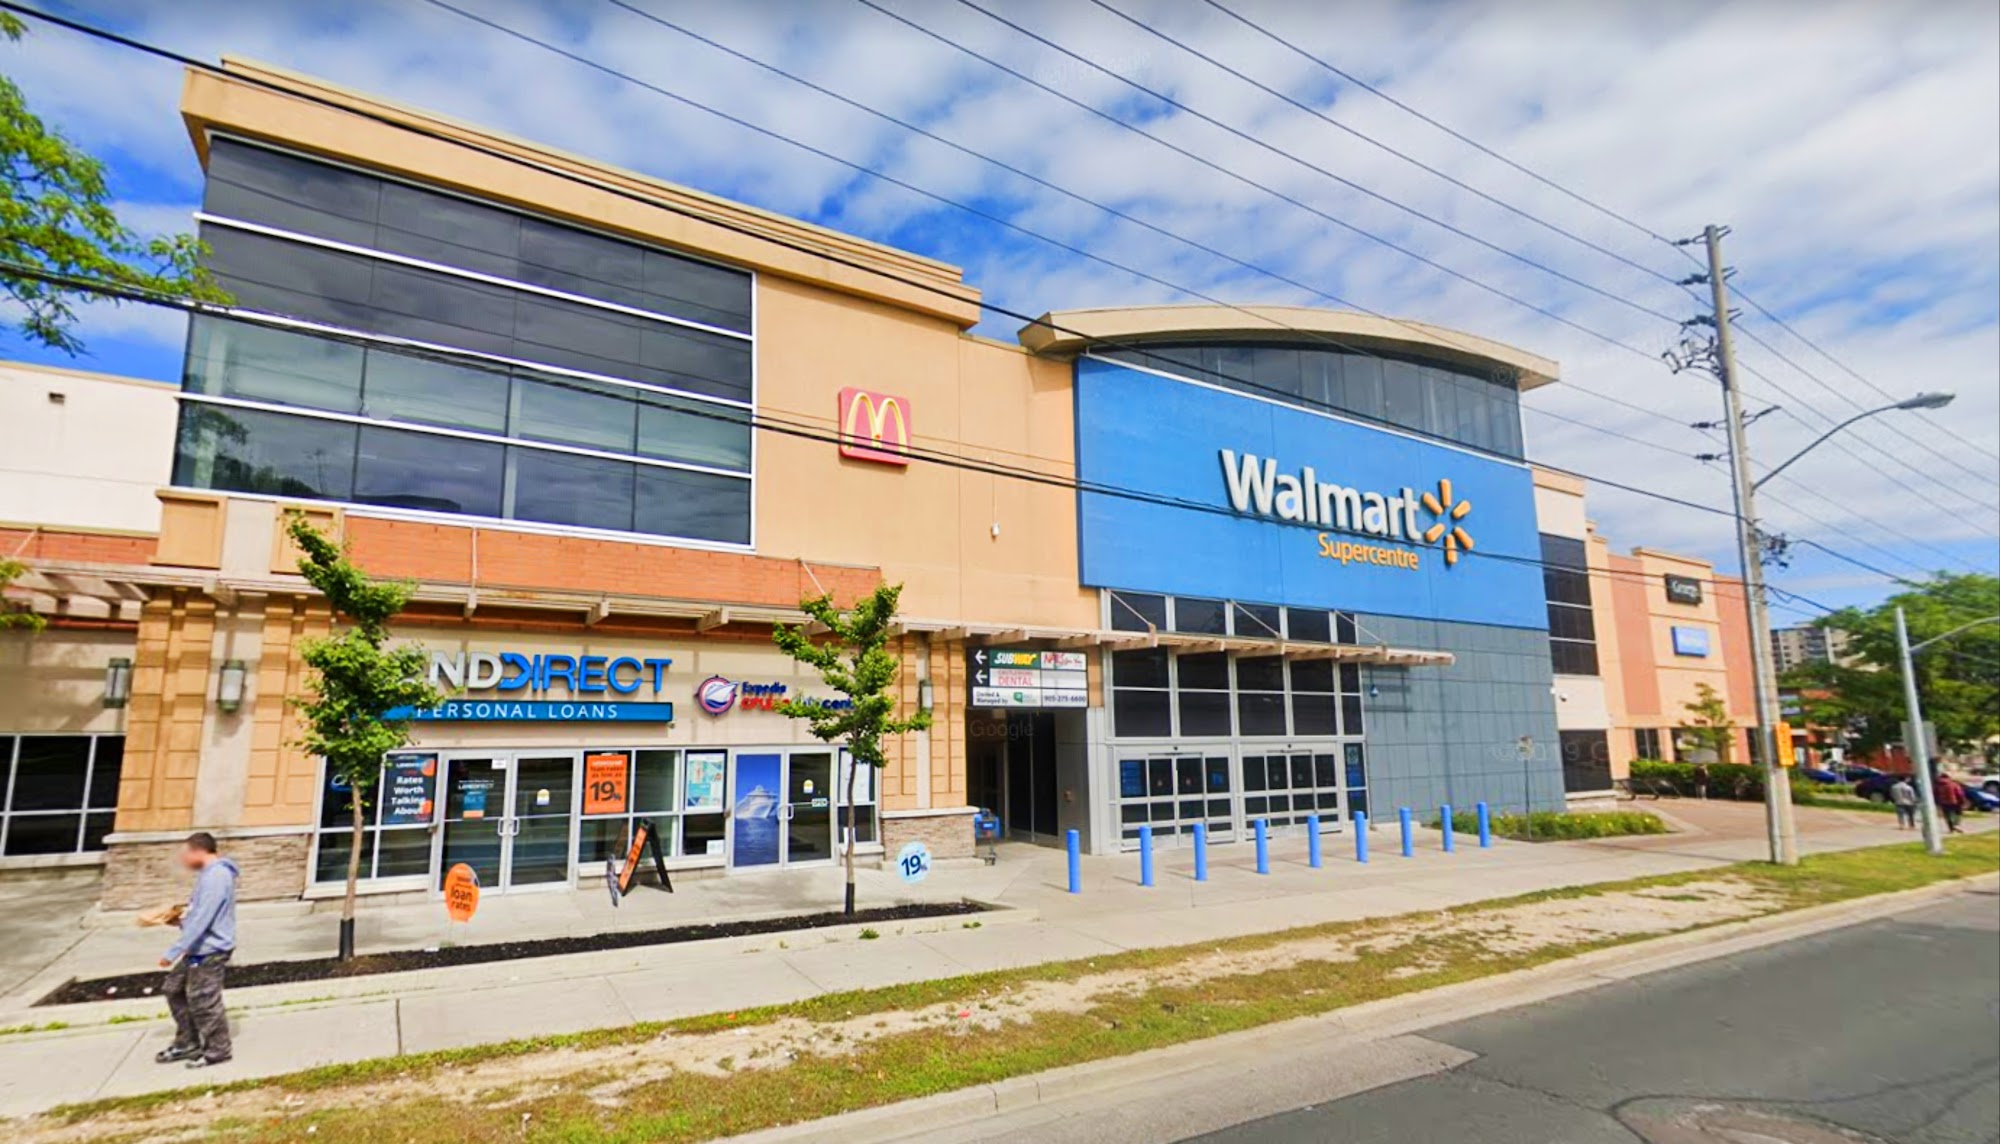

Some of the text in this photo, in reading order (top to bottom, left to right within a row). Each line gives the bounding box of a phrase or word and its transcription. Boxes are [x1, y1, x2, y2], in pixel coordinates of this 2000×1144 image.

[1220, 448, 1422, 541] Walmart
[1317, 532, 1420, 571] Supercentre
[994, 653, 1037, 665] SUBWAY
[998, 676, 1033, 686] DENTAL
[417, 703, 619, 719] PERSONAL LOANS
[396, 776, 423, 785] Rates
[393, 786, 424, 795] Worth
[391, 796, 426, 806] Talking
[451, 886, 473, 902] loan
